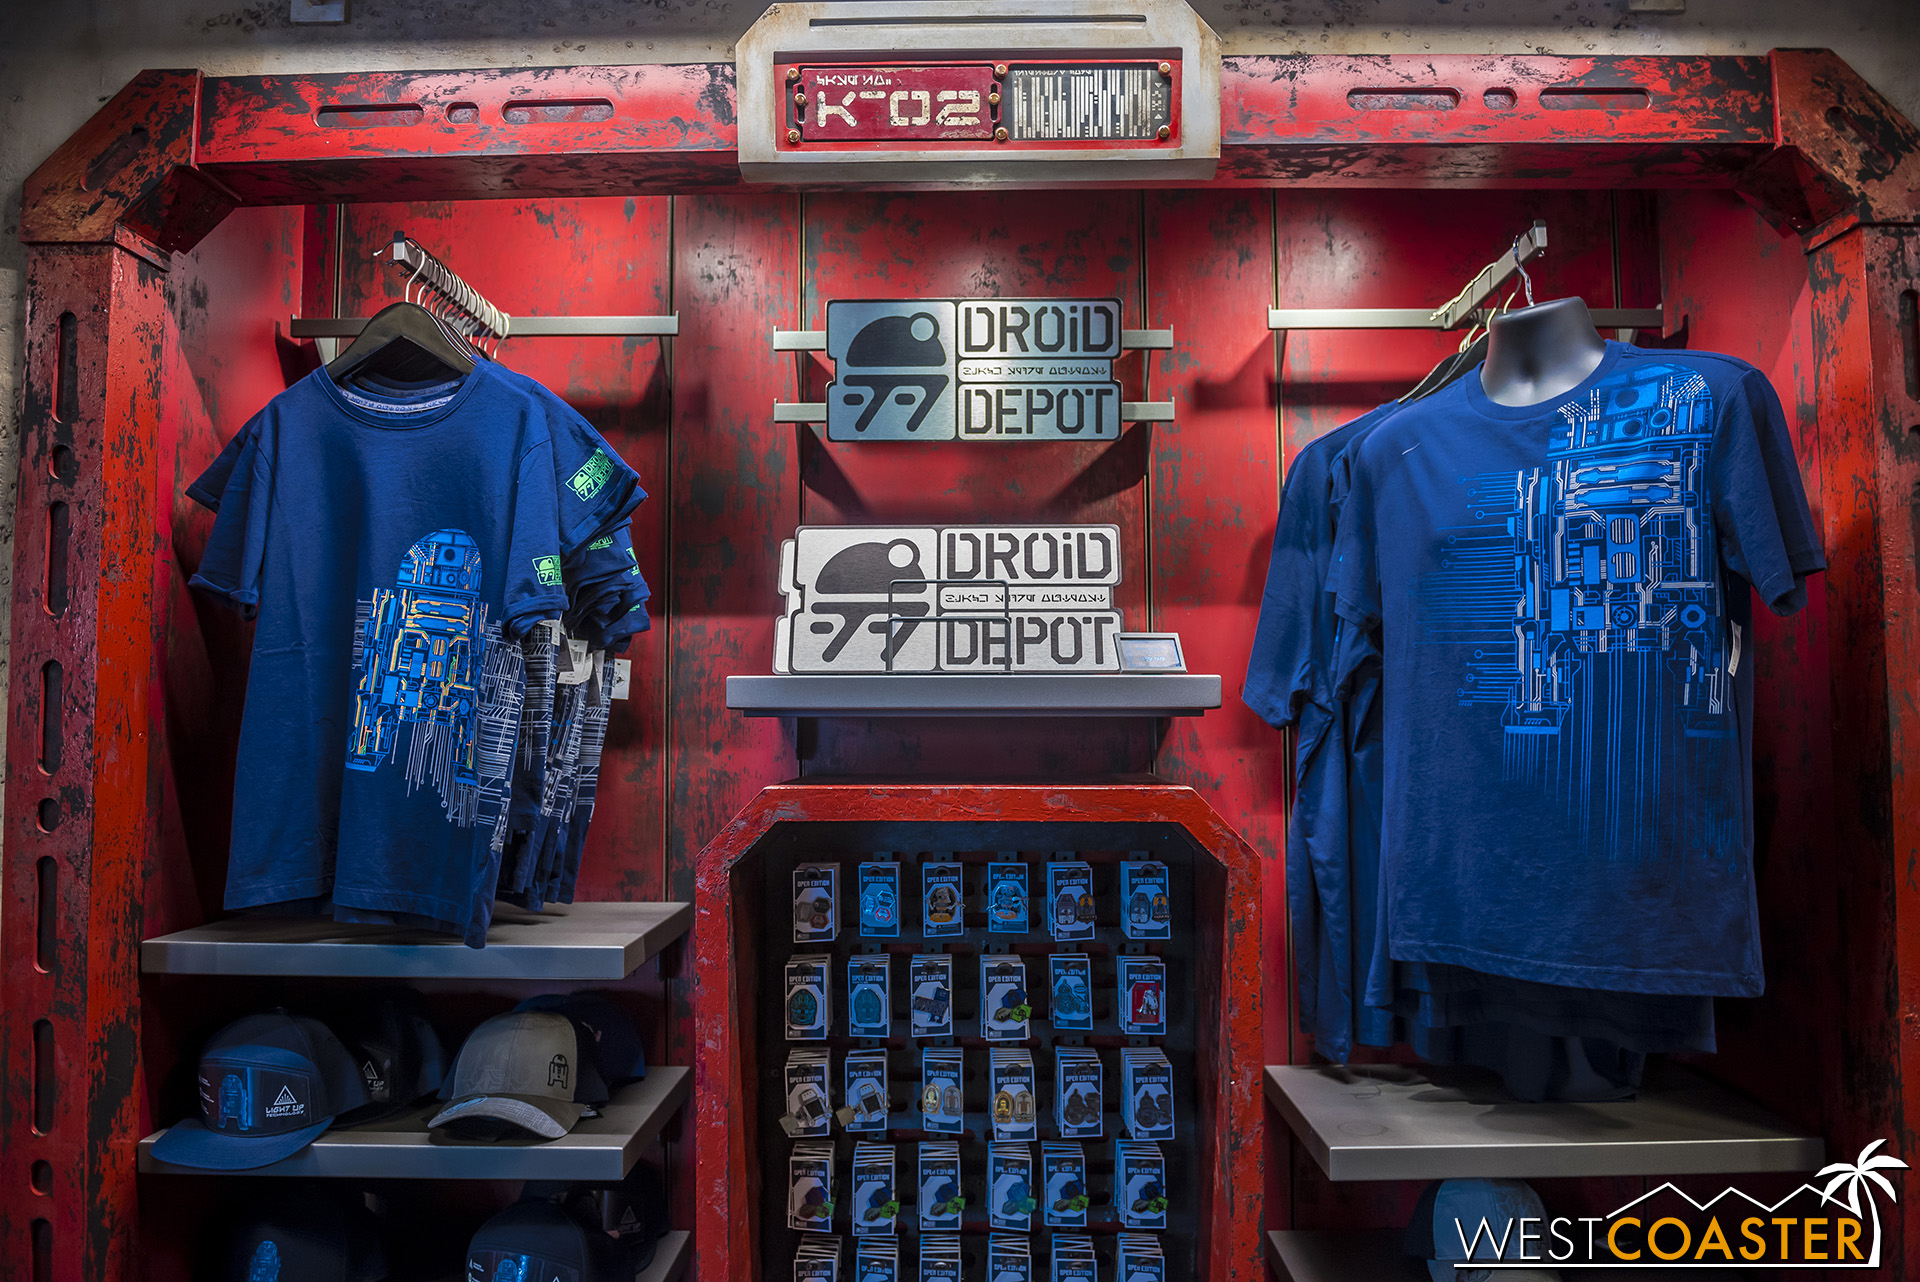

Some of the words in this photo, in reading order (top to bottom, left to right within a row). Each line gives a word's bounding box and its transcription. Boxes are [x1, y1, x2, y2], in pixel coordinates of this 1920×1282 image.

[965, 388, 1114, 435] DEPOT
[946, 616, 1114, 665] DEPOT
[265, 1105, 291, 1114] LIGHT
[292, 1103, 305, 1111] UP
[265, 1110, 305, 1118] TECHNOLOGY
[1008, 1167, 1027, 1175] EDITON
